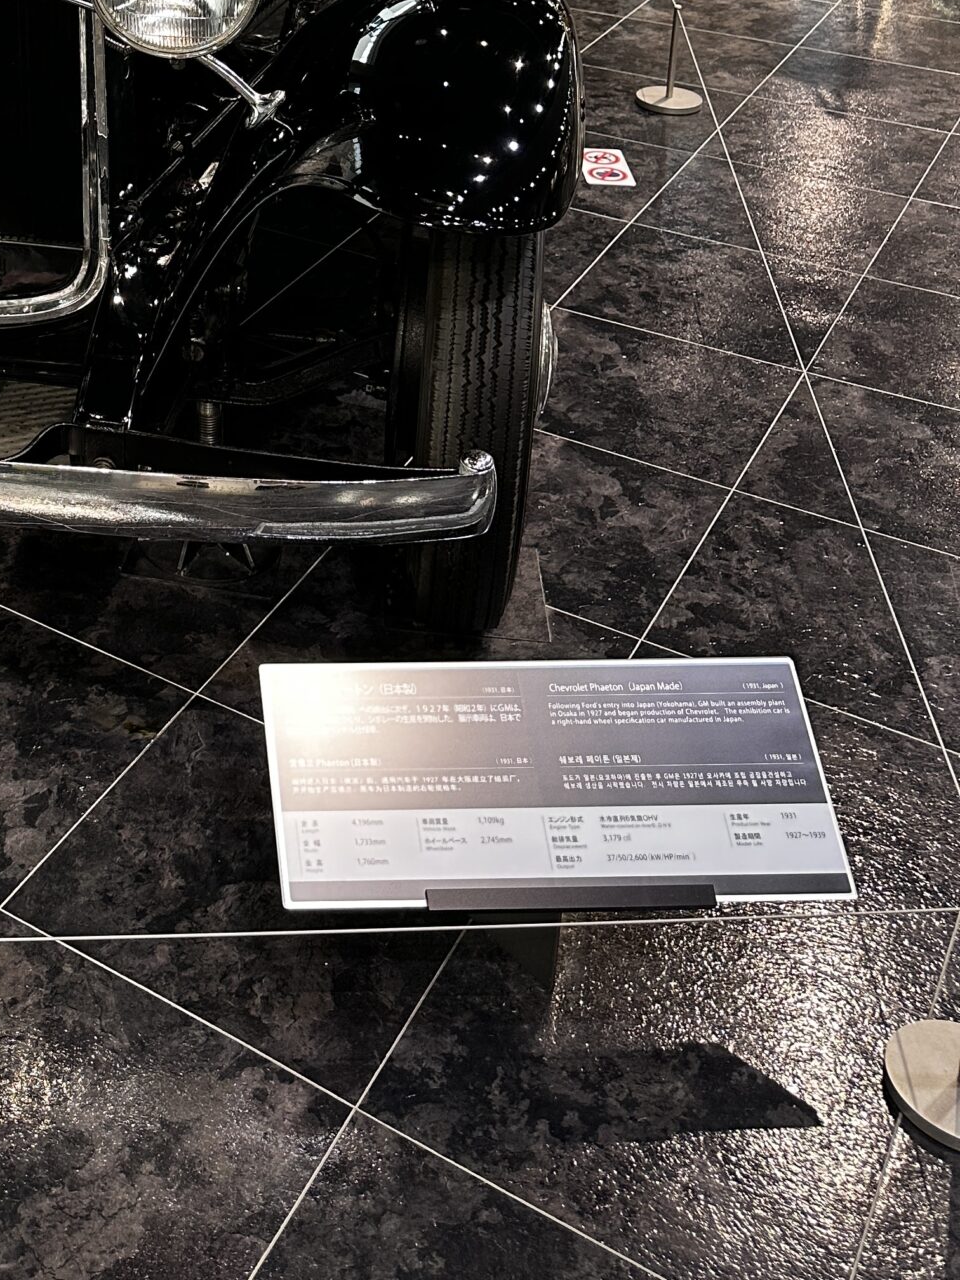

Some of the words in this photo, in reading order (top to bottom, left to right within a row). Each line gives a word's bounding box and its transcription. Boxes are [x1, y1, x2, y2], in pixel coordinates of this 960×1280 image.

[548, 683, 588, 692] Chevrolet
[589, 683, 624, 692] Phaeton
[628, 681, 656, 692] (Japan
[656, 681, 683, 691] Made)
[548, 702, 580, 710] Following
[603, 702, 620, 710] entry
[737, 700, 766, 708] assembly
[618, 709, 638, 717] began
[640, 709, 676, 717] production
[557, 718, 592, 726] right-hand
[614, 717, 656, 725] specification
[780, 812, 797, 820] 1931
